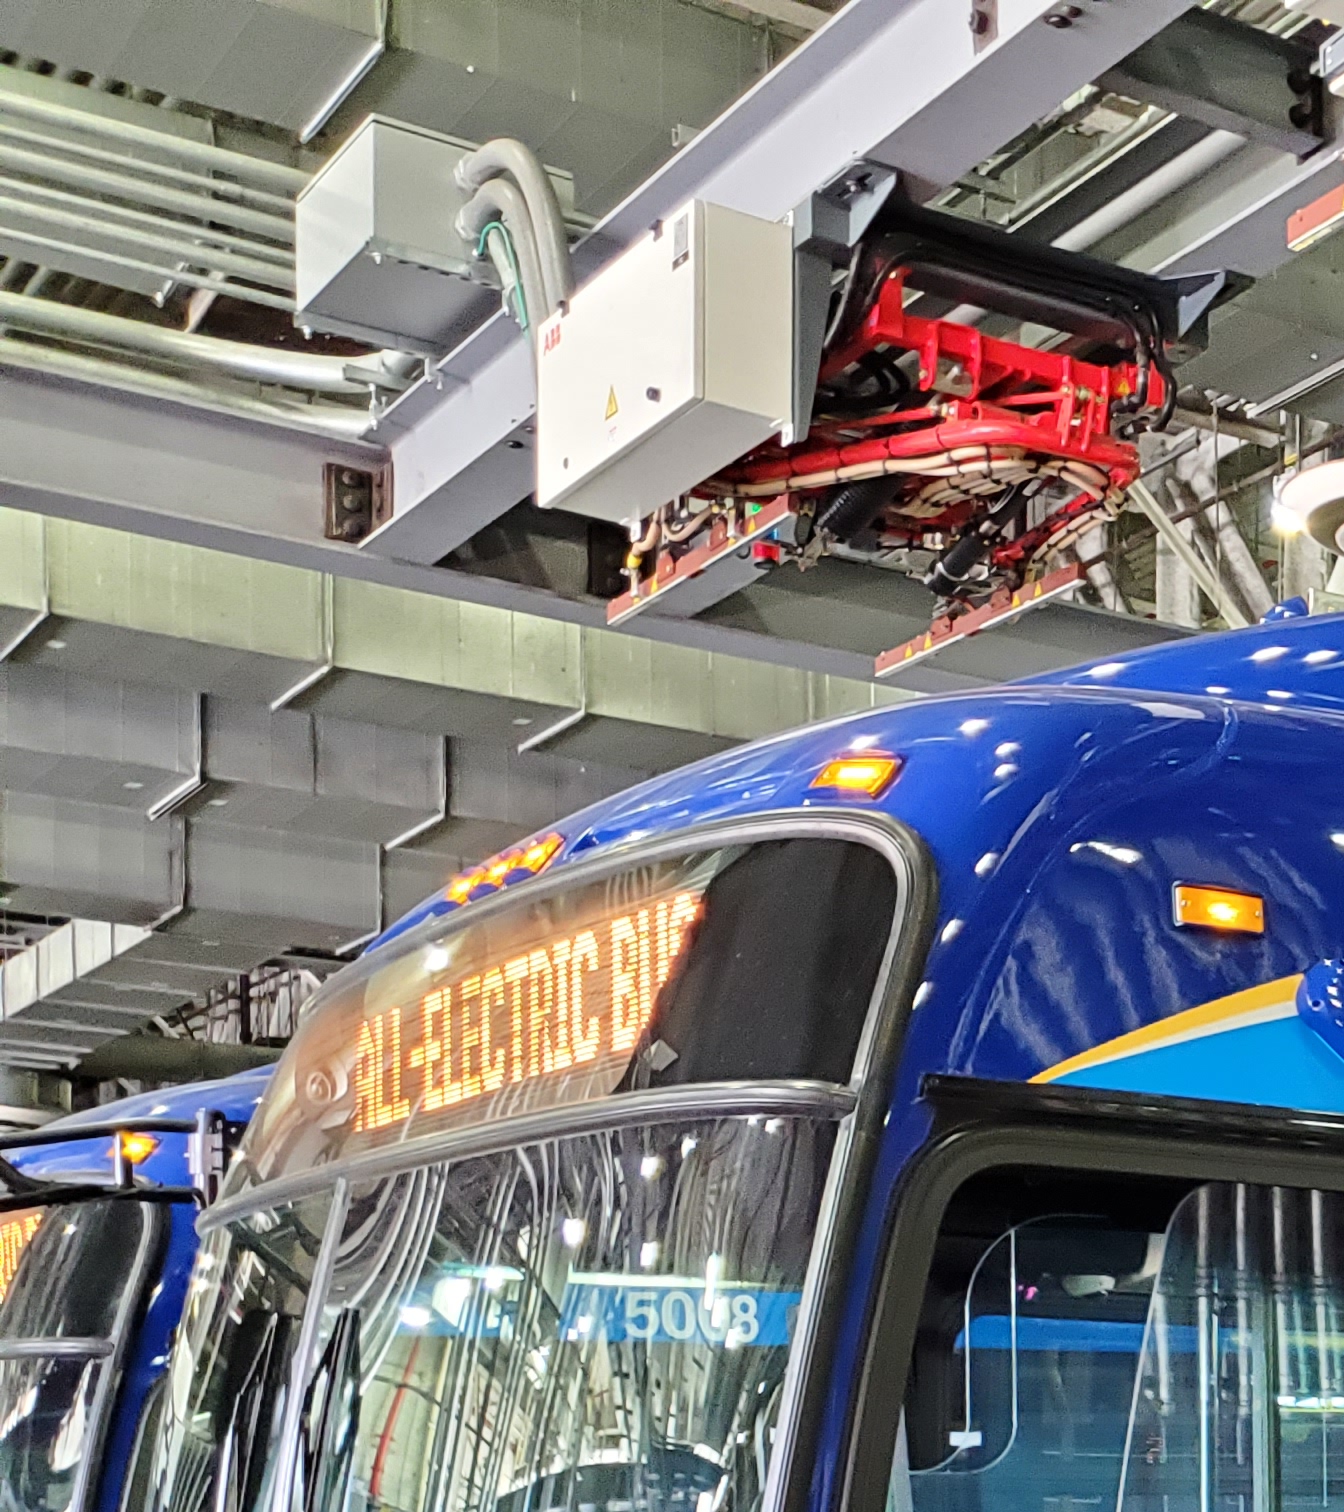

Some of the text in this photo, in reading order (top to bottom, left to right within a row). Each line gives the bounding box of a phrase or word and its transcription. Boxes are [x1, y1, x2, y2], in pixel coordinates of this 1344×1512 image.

[544, 323, 561, 356] ABB
[354, 929, 600, 1132] ALL-ELECTRIC
[625, 1291, 760, 1344] 5008
